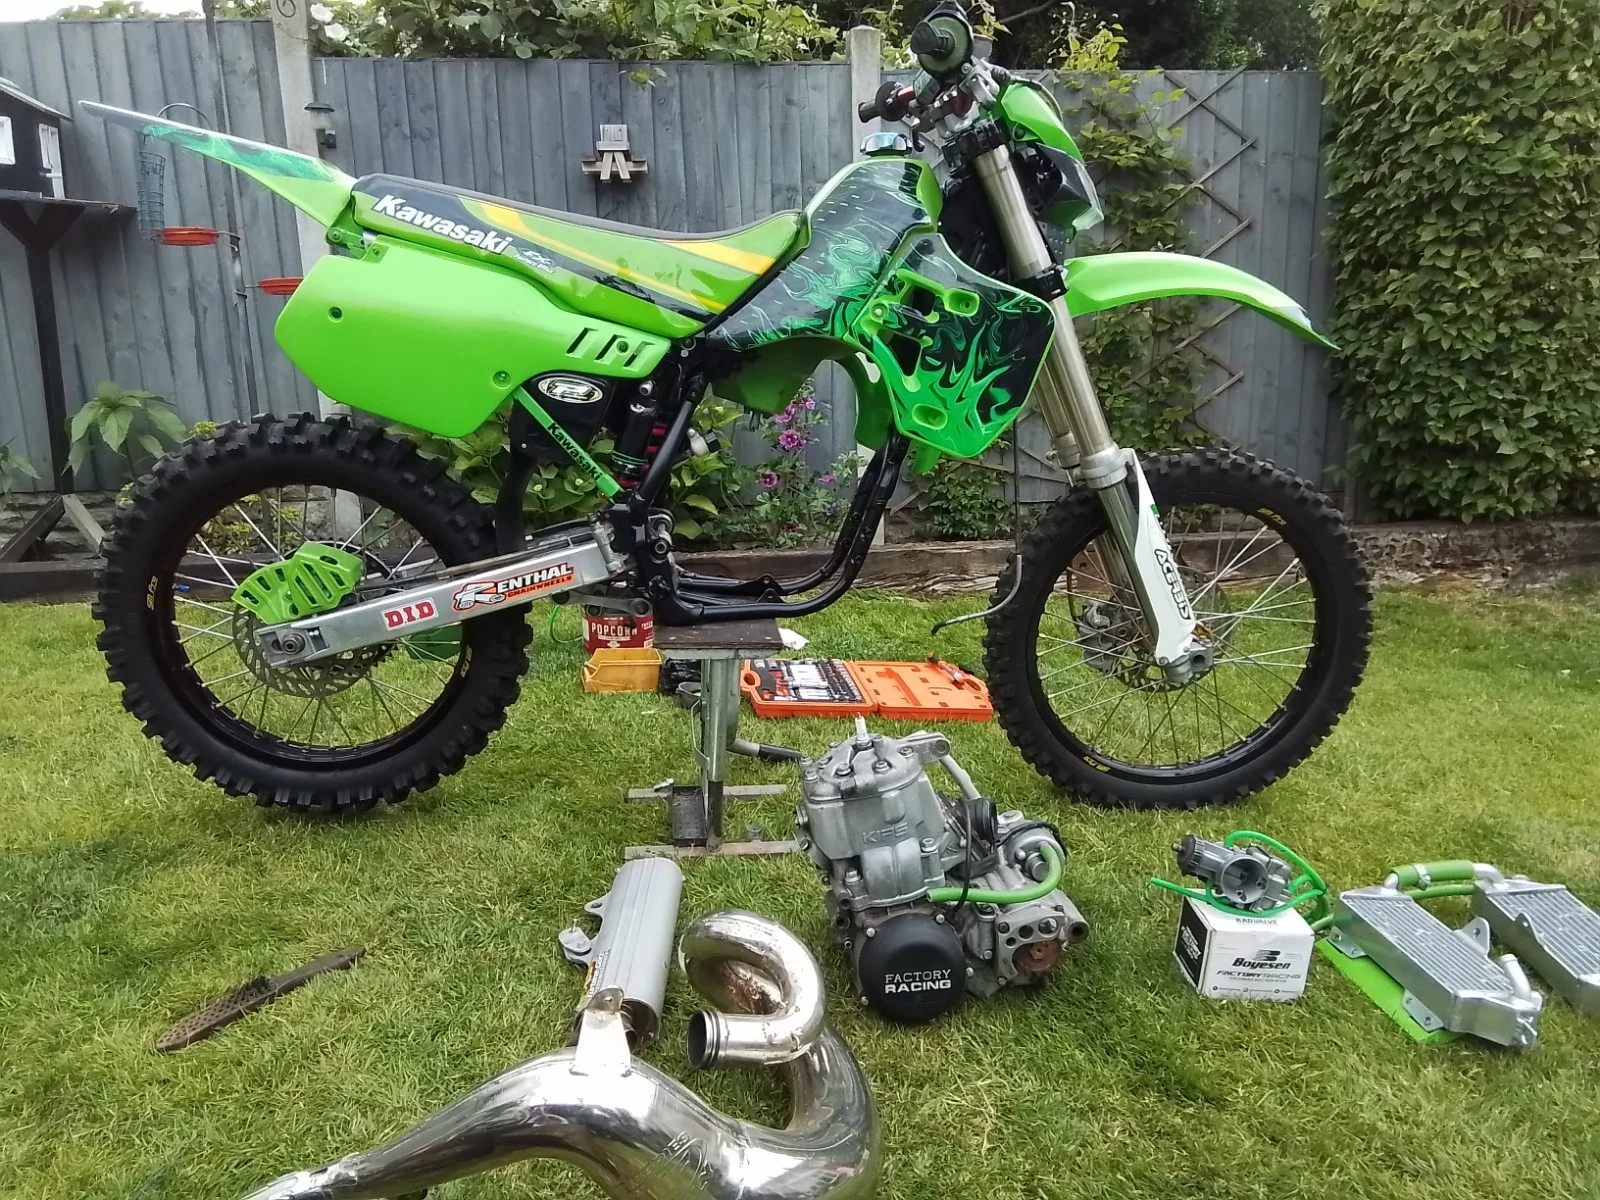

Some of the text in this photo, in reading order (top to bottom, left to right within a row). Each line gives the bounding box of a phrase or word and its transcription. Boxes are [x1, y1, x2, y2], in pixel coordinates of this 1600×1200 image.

[373, 193, 514, 254] Kawasaki
[547, 421, 604, 481] Kawasaki
[453, 563, 574, 611] RENTHAL
[507, 575, 573, 598] CHAINWHEELS
[1154, 548, 1192, 621] ACERBIS
[884, 968, 952, 984] FACTORY
[1231, 956, 1292, 970] Boyesen
[884, 979, 952, 994] RACING
